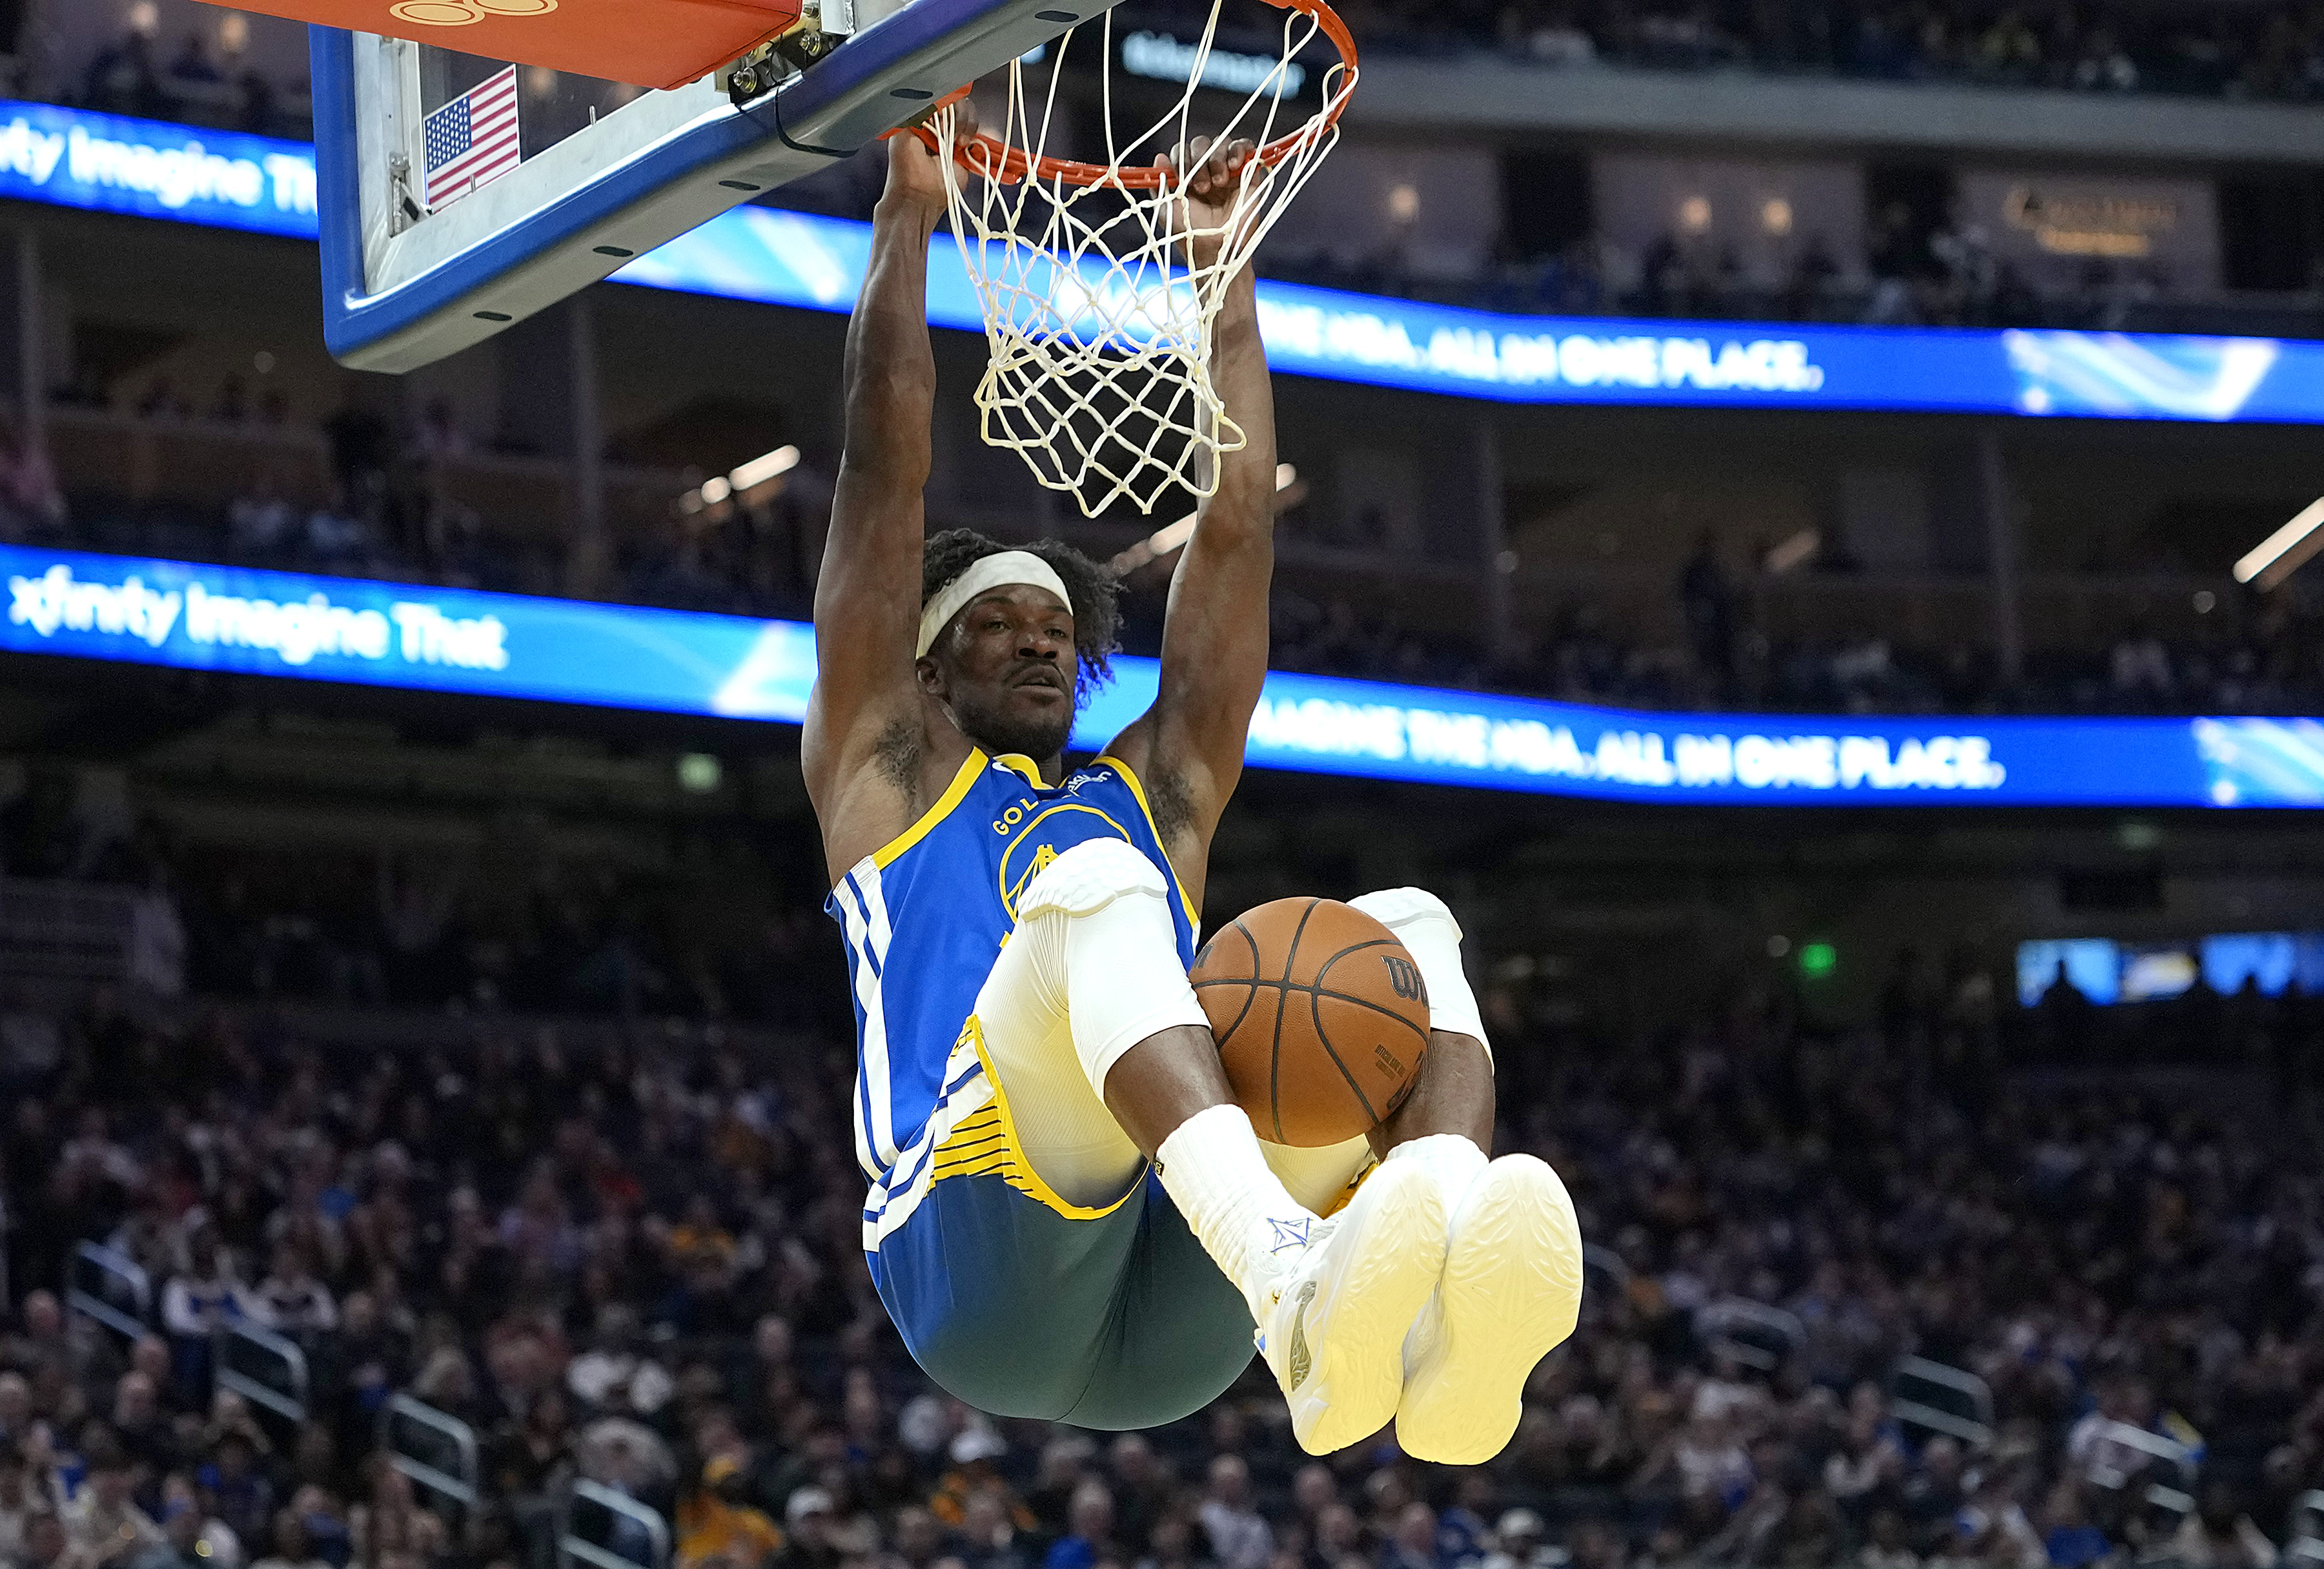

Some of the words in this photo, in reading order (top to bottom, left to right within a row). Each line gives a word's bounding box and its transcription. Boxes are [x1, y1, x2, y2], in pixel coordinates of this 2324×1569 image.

[1428, 326, 1500, 382] ALL
[1498, 333, 1558, 385] IN
[1558, 333, 1660, 388] ONE
[185, 581, 390, 665] Imagine
[391, 601, 509, 671] That
[1407, 708, 1491, 769] THE
[1594, 730, 1677, 787] ALL
[1673, 733, 1733, 788] IN
[1733, 733, 1839, 790] ONE
